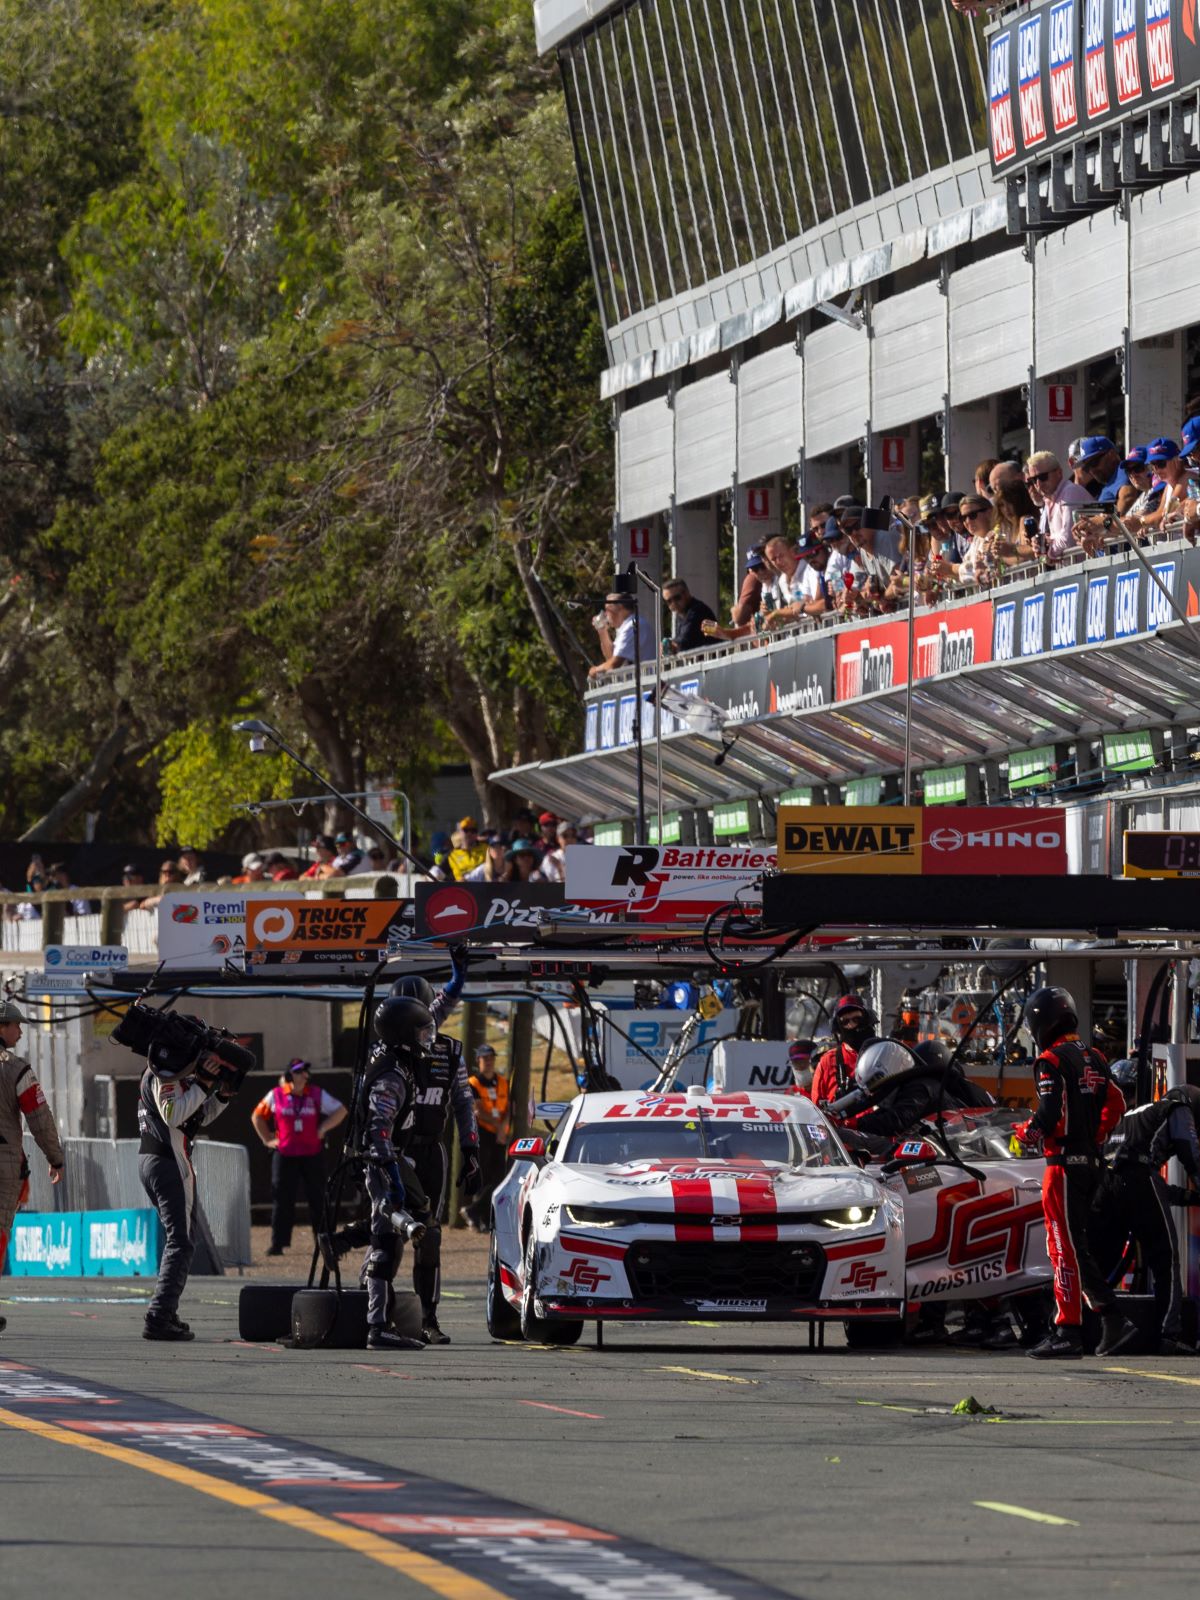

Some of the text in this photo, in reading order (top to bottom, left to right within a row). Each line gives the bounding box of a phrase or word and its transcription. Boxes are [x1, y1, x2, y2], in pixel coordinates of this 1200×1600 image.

[1049, 6, 1073, 66] LIQUI
[1018, 24, 1041, 82] LIQUI
[1146, 20, 1174, 86] MOLY
[1113, 37, 1141, 99] MOLY
[1086, 51, 1108, 114] MOLY
[1050, 66, 1077, 129] MOLY
[1019, 84, 1046, 142] MOLY
[991, 100, 1016, 158] MOLY
[784, 825, 914, 852] DeWALT
[968, 832, 1061, 848] HINO
[662, 849, 778, 868] Batteries
[697, 873, 709, 881] like
[711, 873, 735, 883] nothing
[298, 907, 369, 923] TRUCK
[292, 925, 367, 941] ASSIST
[66, 950, 127, 961] CoolDrive
[314, 953, 354, 961] coregas
[603, 1103, 791, 1123] Liberty
[684, 1121, 696, 1131] 4
[742, 1123, 787, 1132] Smith
[841, 1261, 888, 1292] SCT
[910, 1260, 1003, 1300] LOGISTICS
